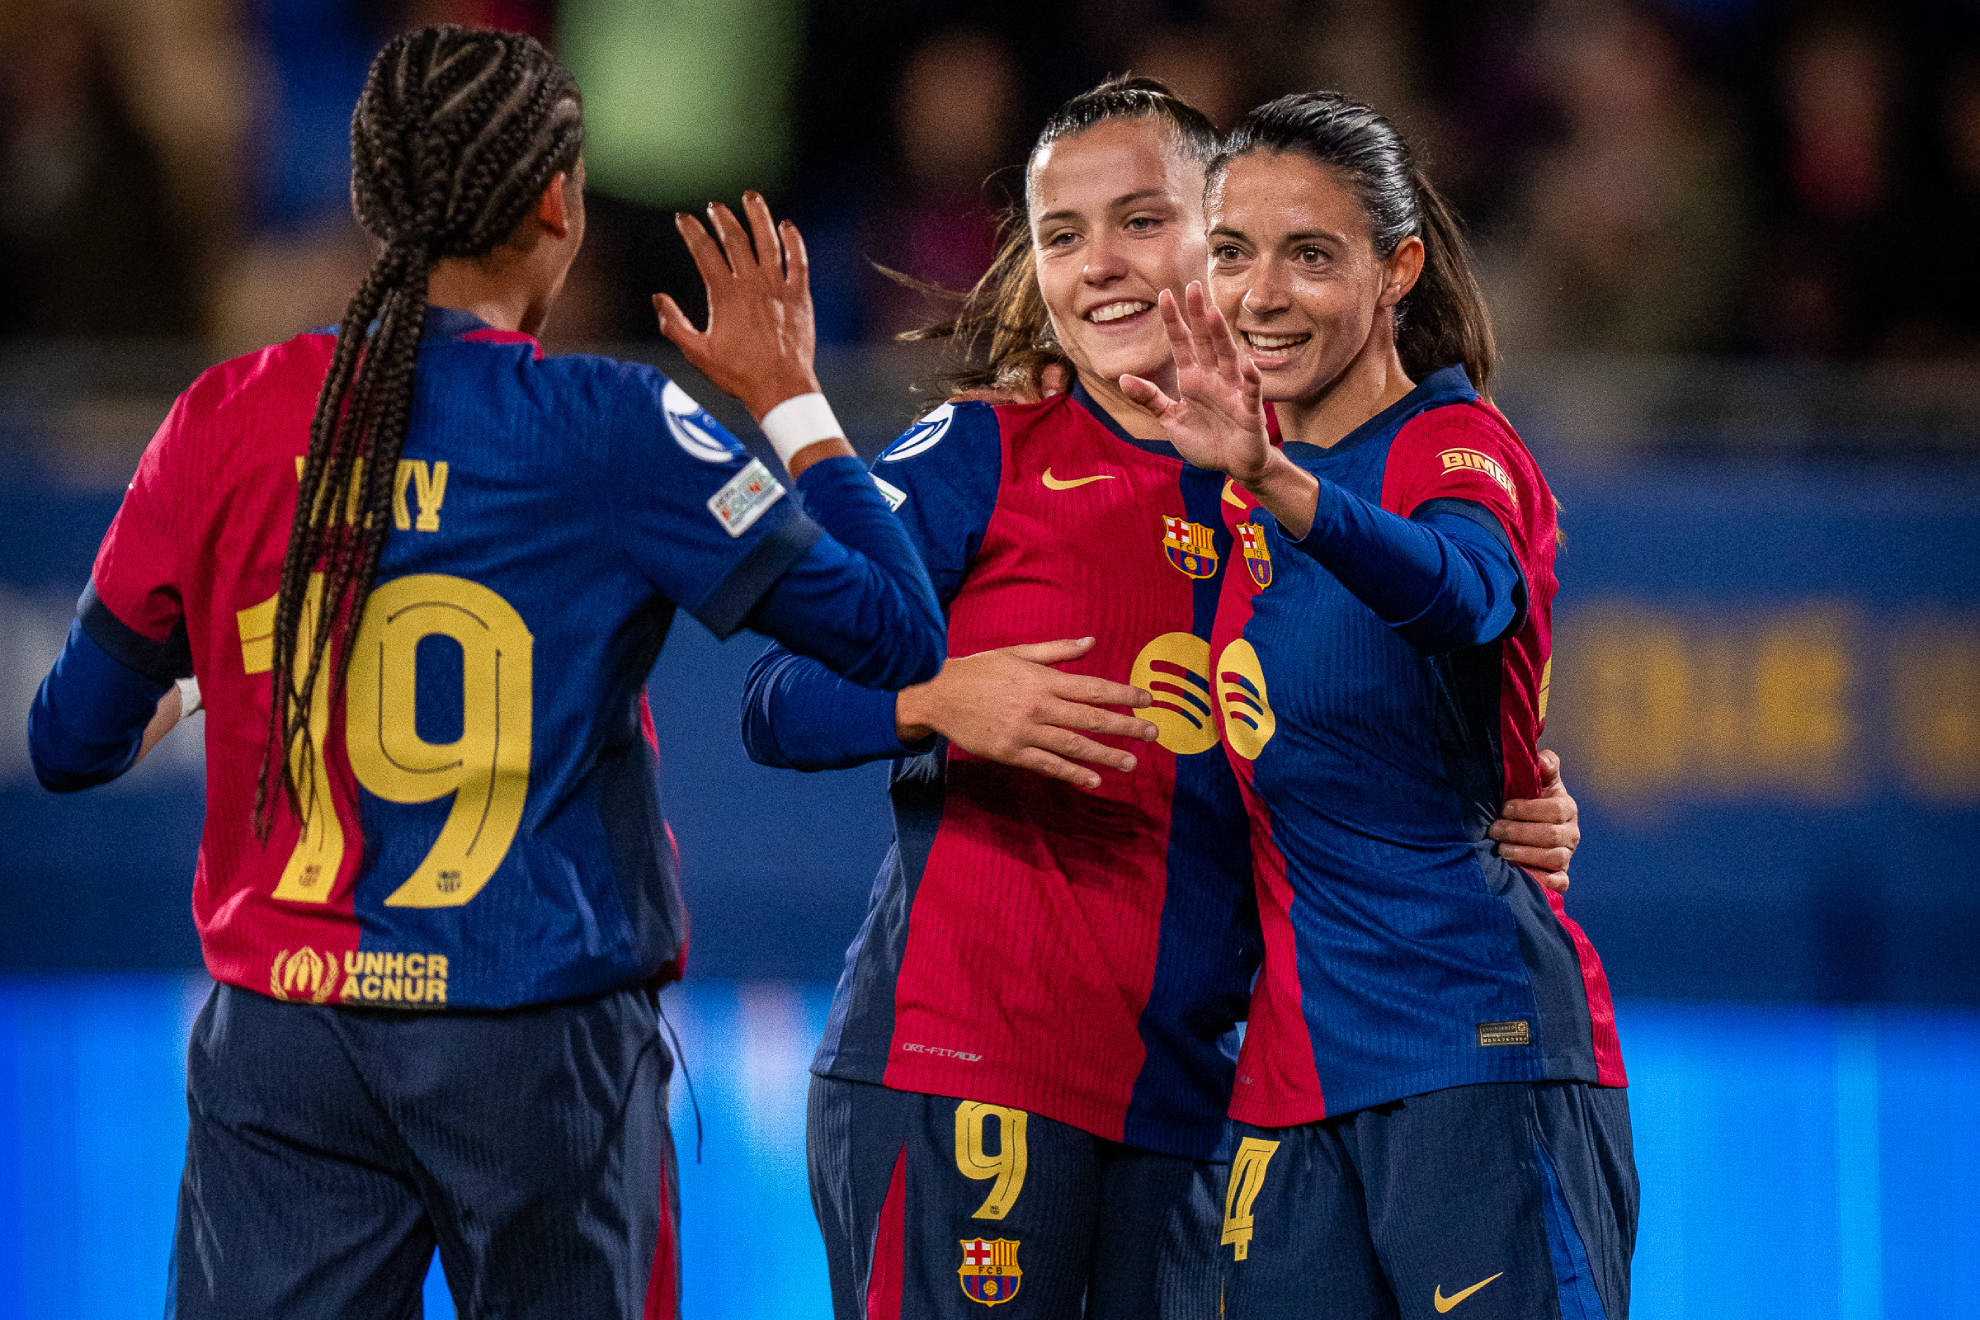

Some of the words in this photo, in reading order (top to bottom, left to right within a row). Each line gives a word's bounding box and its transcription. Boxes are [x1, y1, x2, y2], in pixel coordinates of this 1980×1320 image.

[1179, 541, 1201, 555] FCB
[237, 572, 534, 909] 19
[344, 950, 449, 979] UNHCR
[339, 975, 448, 1003] ACNUR
[955, 1100, 1028, 1220] 9
[978, 1266, 1003, 1275] FCB
